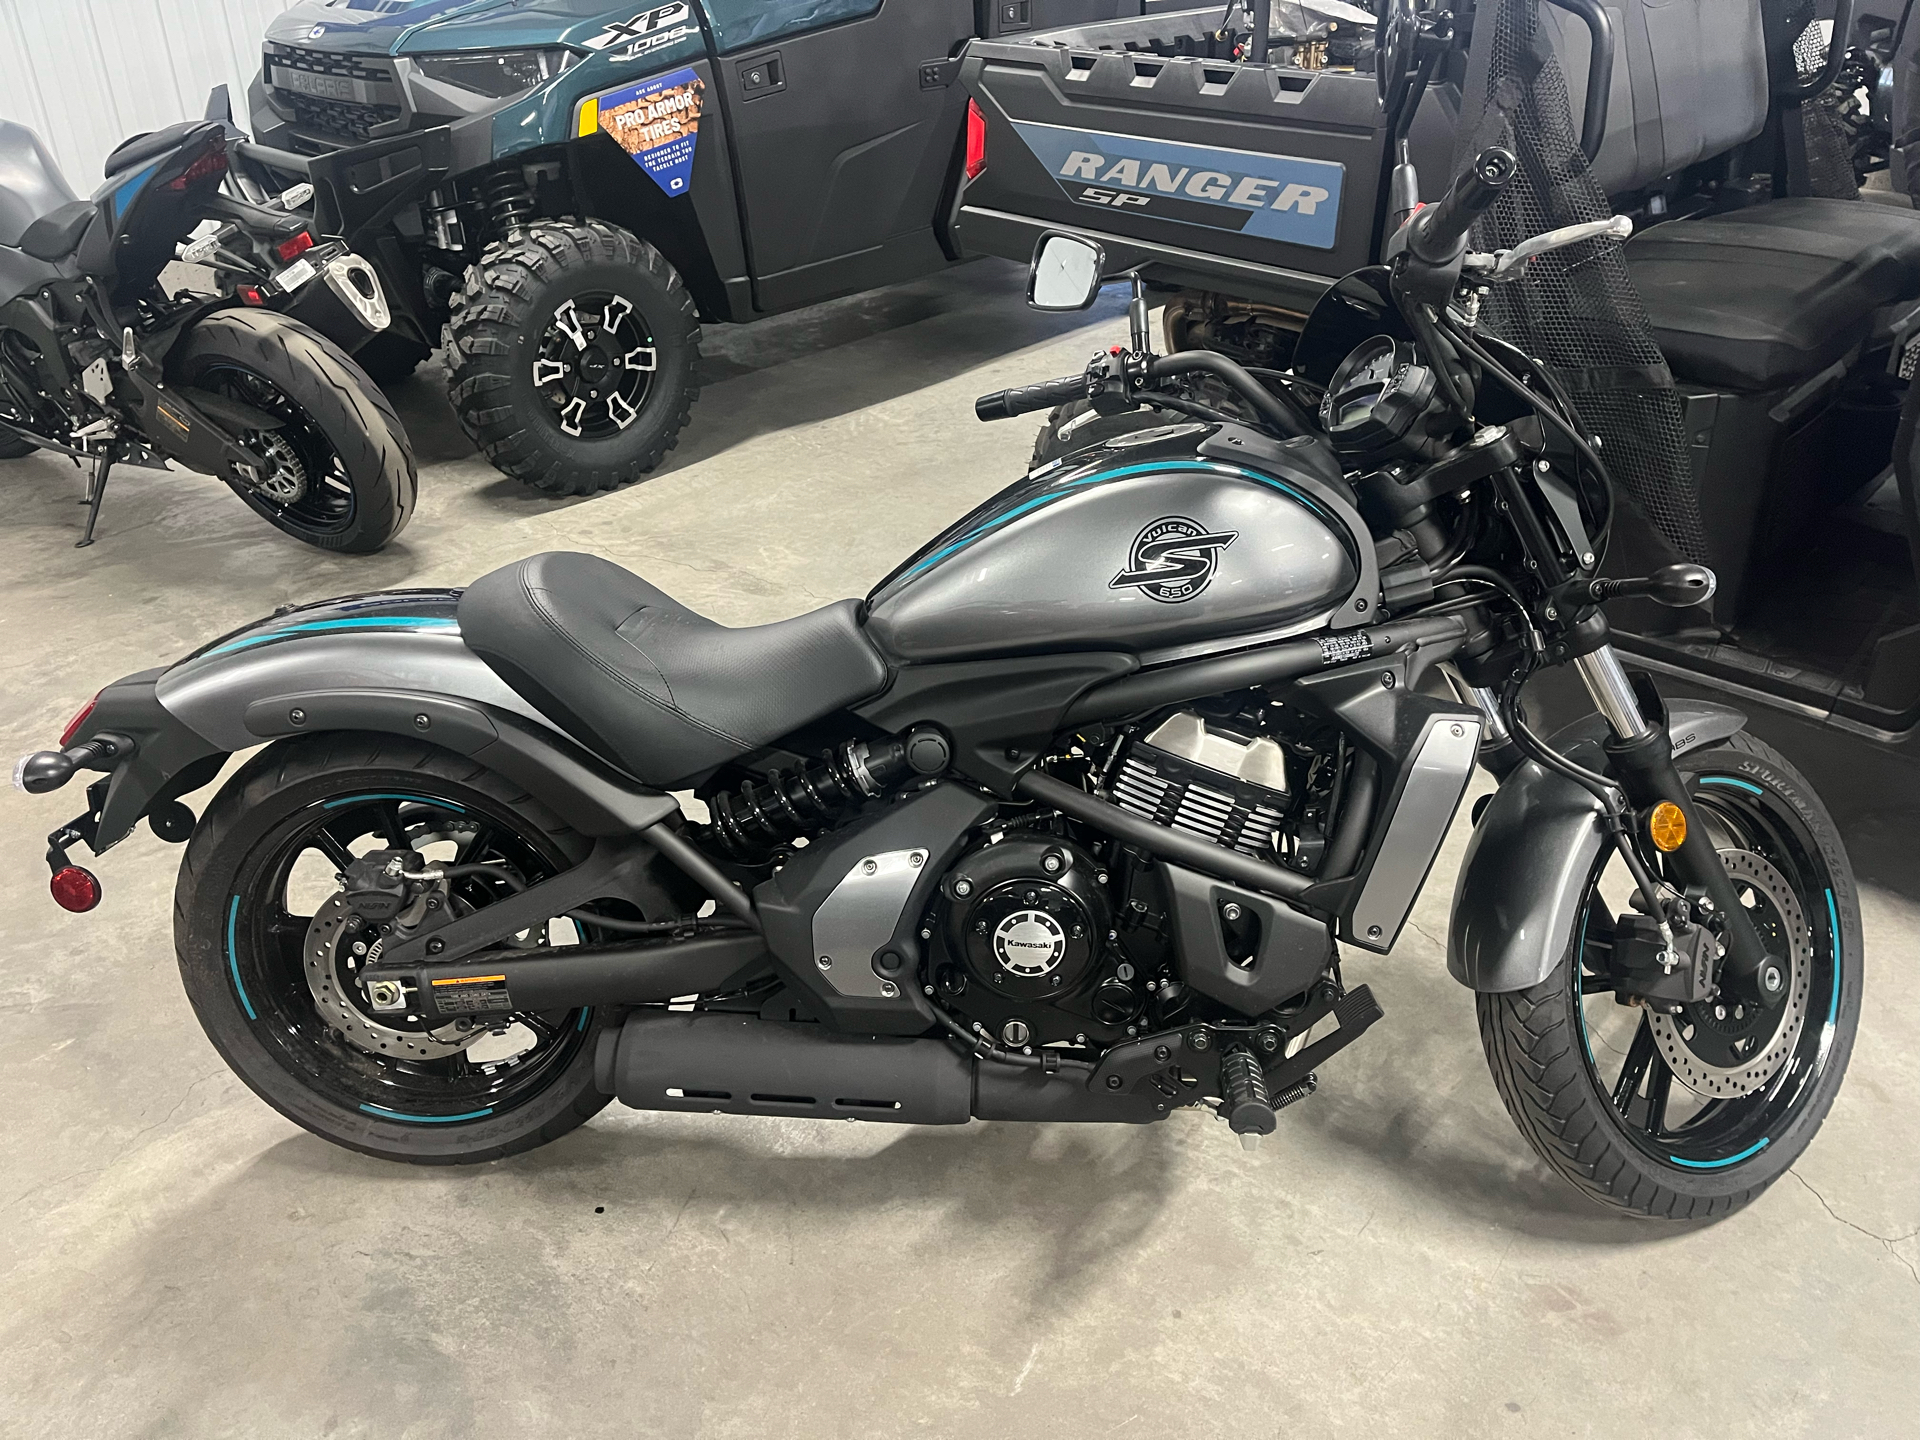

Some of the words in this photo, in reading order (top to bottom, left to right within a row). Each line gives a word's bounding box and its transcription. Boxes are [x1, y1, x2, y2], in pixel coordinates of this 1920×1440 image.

[601, 2, 685, 47] XP
[614, 108, 646, 130] PRO
[647, 91, 695, 121] ARMOR
[640, 117, 682, 142] TIRES
[671, 144, 680, 152] TO
[680, 140, 690, 149] FIT
[1059, 150, 1330, 216] RANGER
[1078, 187, 1151, 207] SP
[1159, 584, 1193, 598] 650
[1007, 939, 1052, 949] Kawasaki
